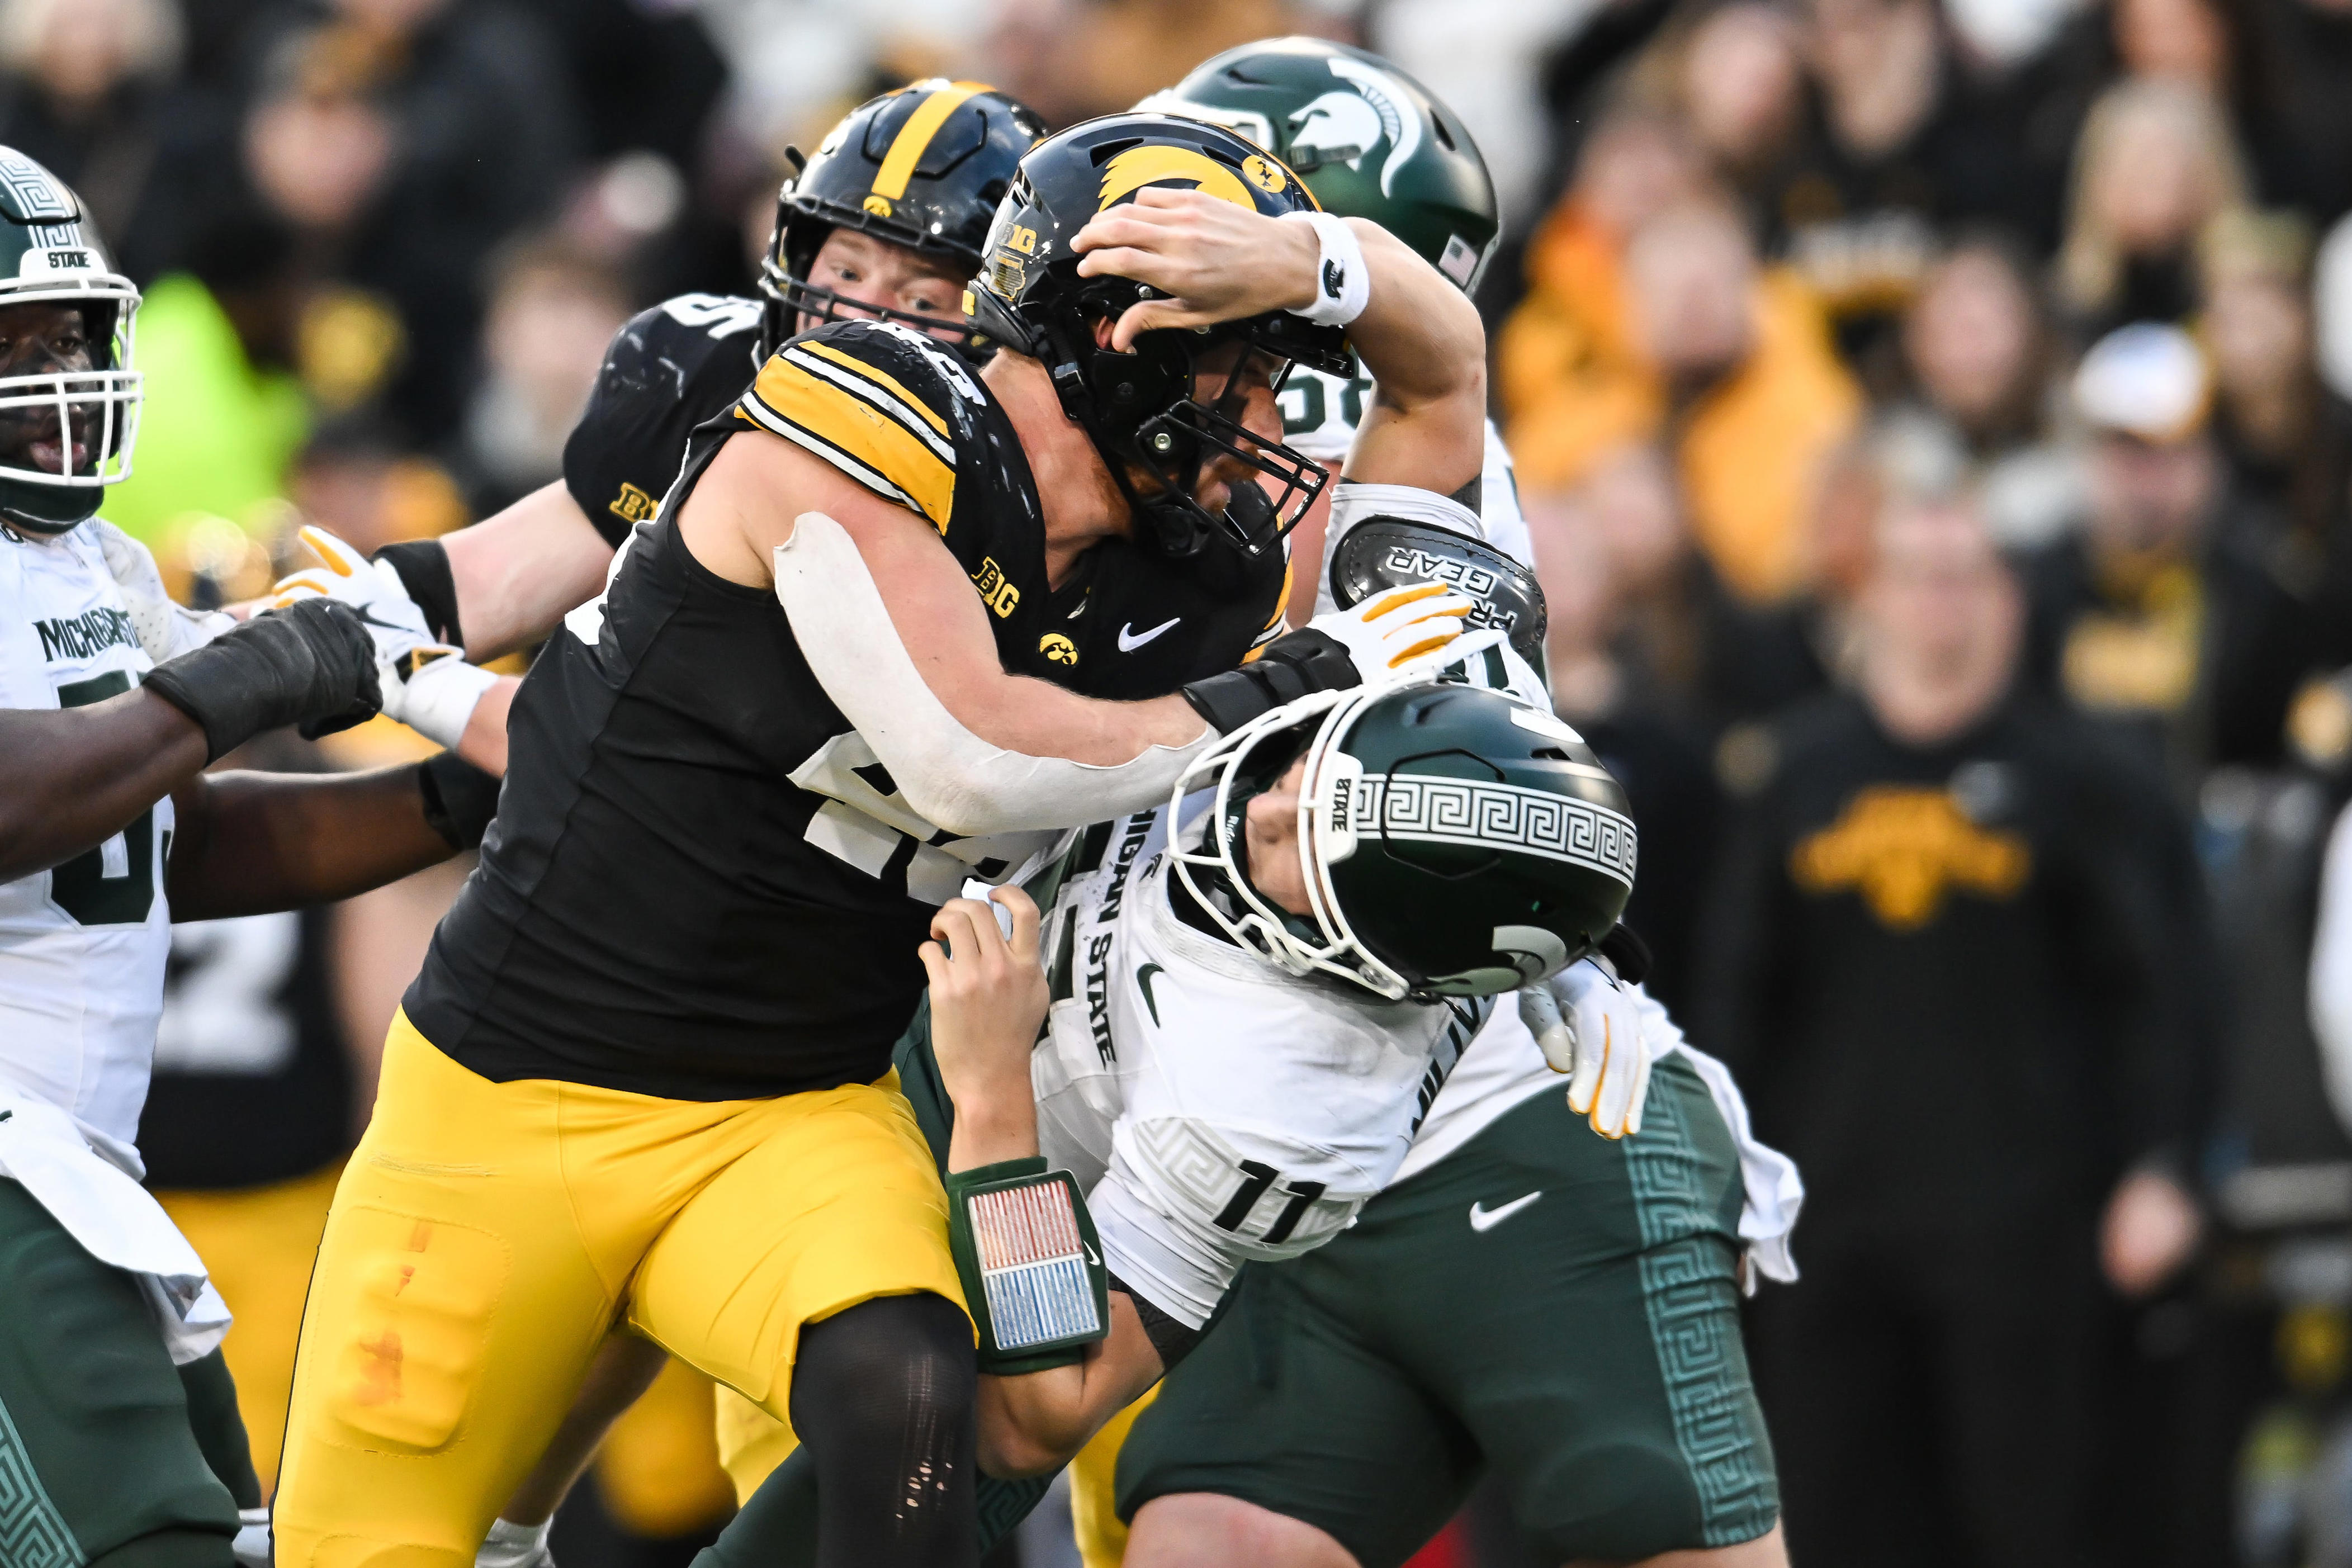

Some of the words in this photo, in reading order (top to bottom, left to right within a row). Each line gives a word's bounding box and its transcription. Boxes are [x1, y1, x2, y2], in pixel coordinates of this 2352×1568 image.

[47, 251, 91, 268] STATE
[1385, 545, 1498, 599] GEAR
[1332, 778, 1352, 832] STATE
[1086, 931, 1118, 1072] STATE
[1212, 1158, 1327, 1244] 11
